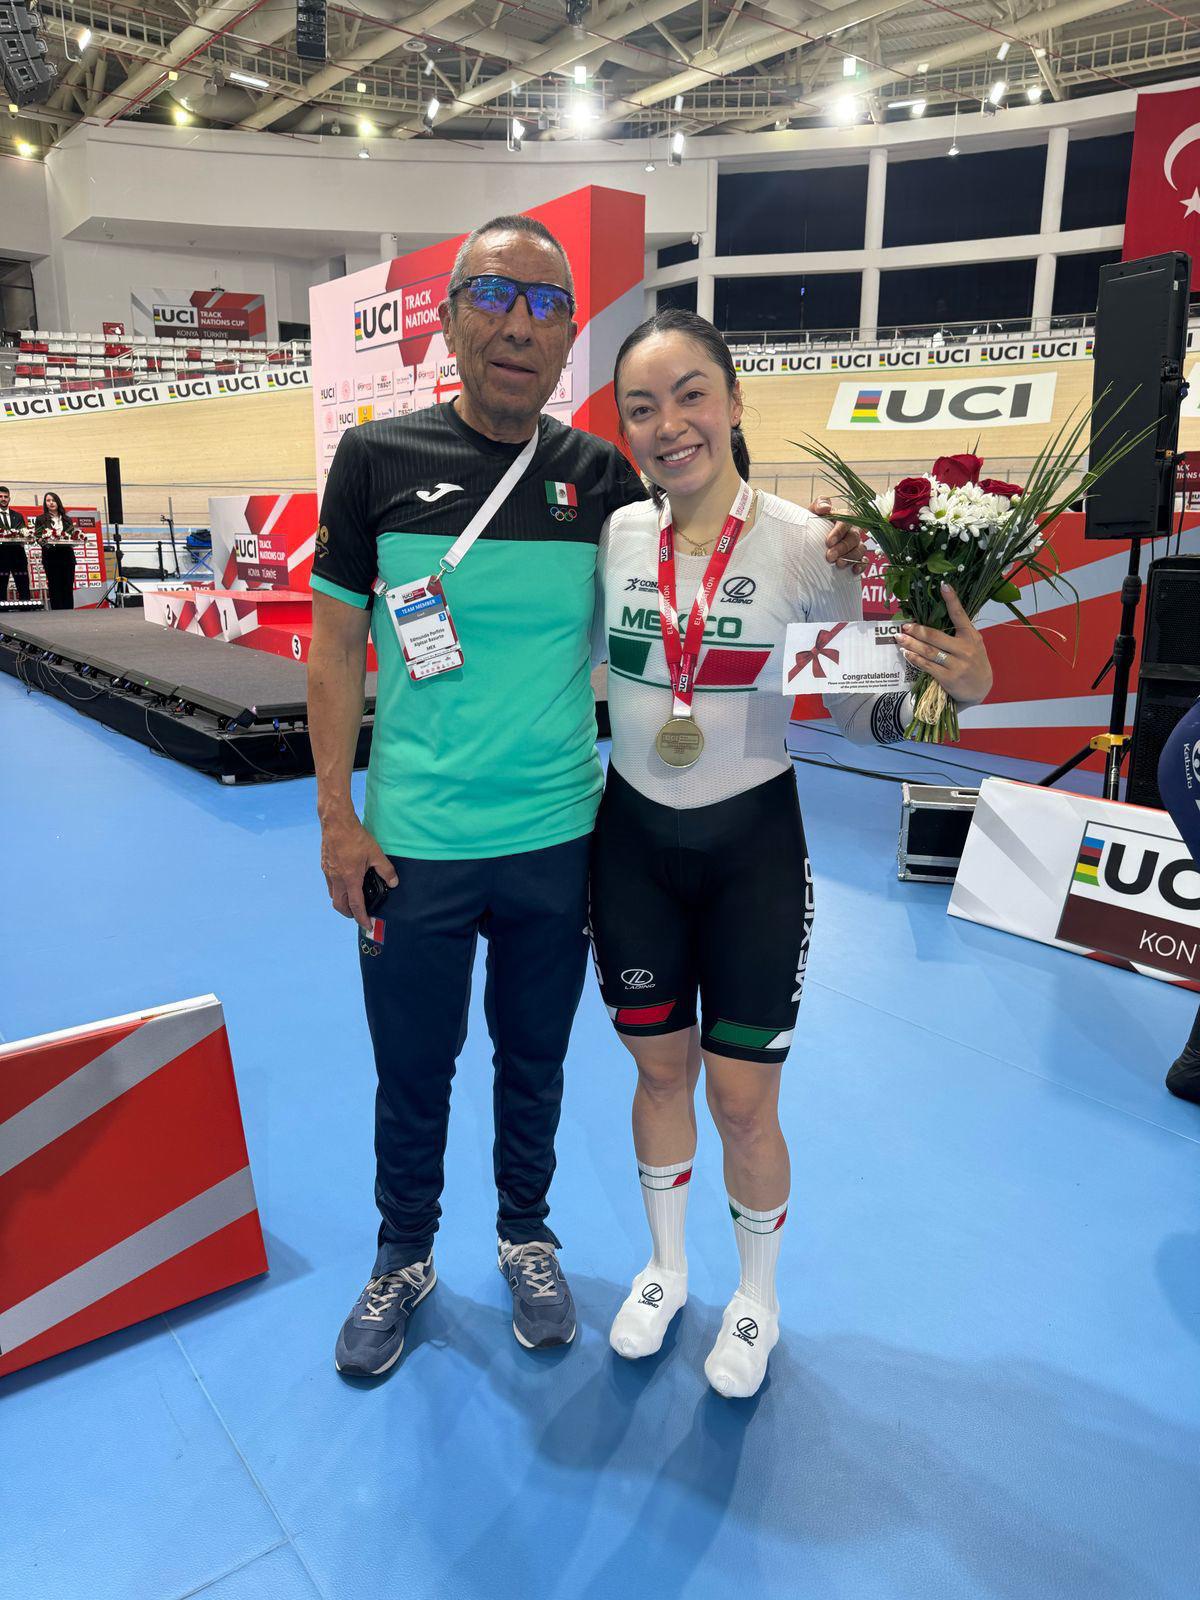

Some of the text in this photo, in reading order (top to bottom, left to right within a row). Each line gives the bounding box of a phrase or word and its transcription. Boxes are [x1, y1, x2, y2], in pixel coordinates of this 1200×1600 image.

[405, 289, 431, 310] TRACK
[162, 309, 194, 324] UCI
[363, 300, 398, 338] UCI
[742, 342, 1077, 372] UCI UCI UCI UCI UCI UCI UCI
[443, 364, 459, 377] UCI
[13, 370, 309, 416] UCI UCI UCI UCI UCI UCI
[323, 387, 335, 399] UCI
[885, 382, 1032, 424] UCI
[341, 412, 354, 424] UCI
[240, 539, 257, 558] UCI
[259, 540, 272, 549] TRACK
[719, 537, 729, 550] UCI
[277, 552, 285, 560] CUP
[402, 599, 436, 614] TEAM MEMBER
[223, 610, 228, 630] 1
[621, 606, 742, 639] MEXCO
[880, 626, 900, 635] UCI
[293, 638, 300, 655] 3
[679, 675, 688, 690] UCI
[842, 672, 900, 680] Congratulations!
[1104, 841, 1200, 910] UC
[791, 857, 815, 1003] MEXICO
[1139, 929, 1199, 964] KON
[638, 1298, 660, 1309] LADINO
[732, 1331, 755, 1347] LADINO
